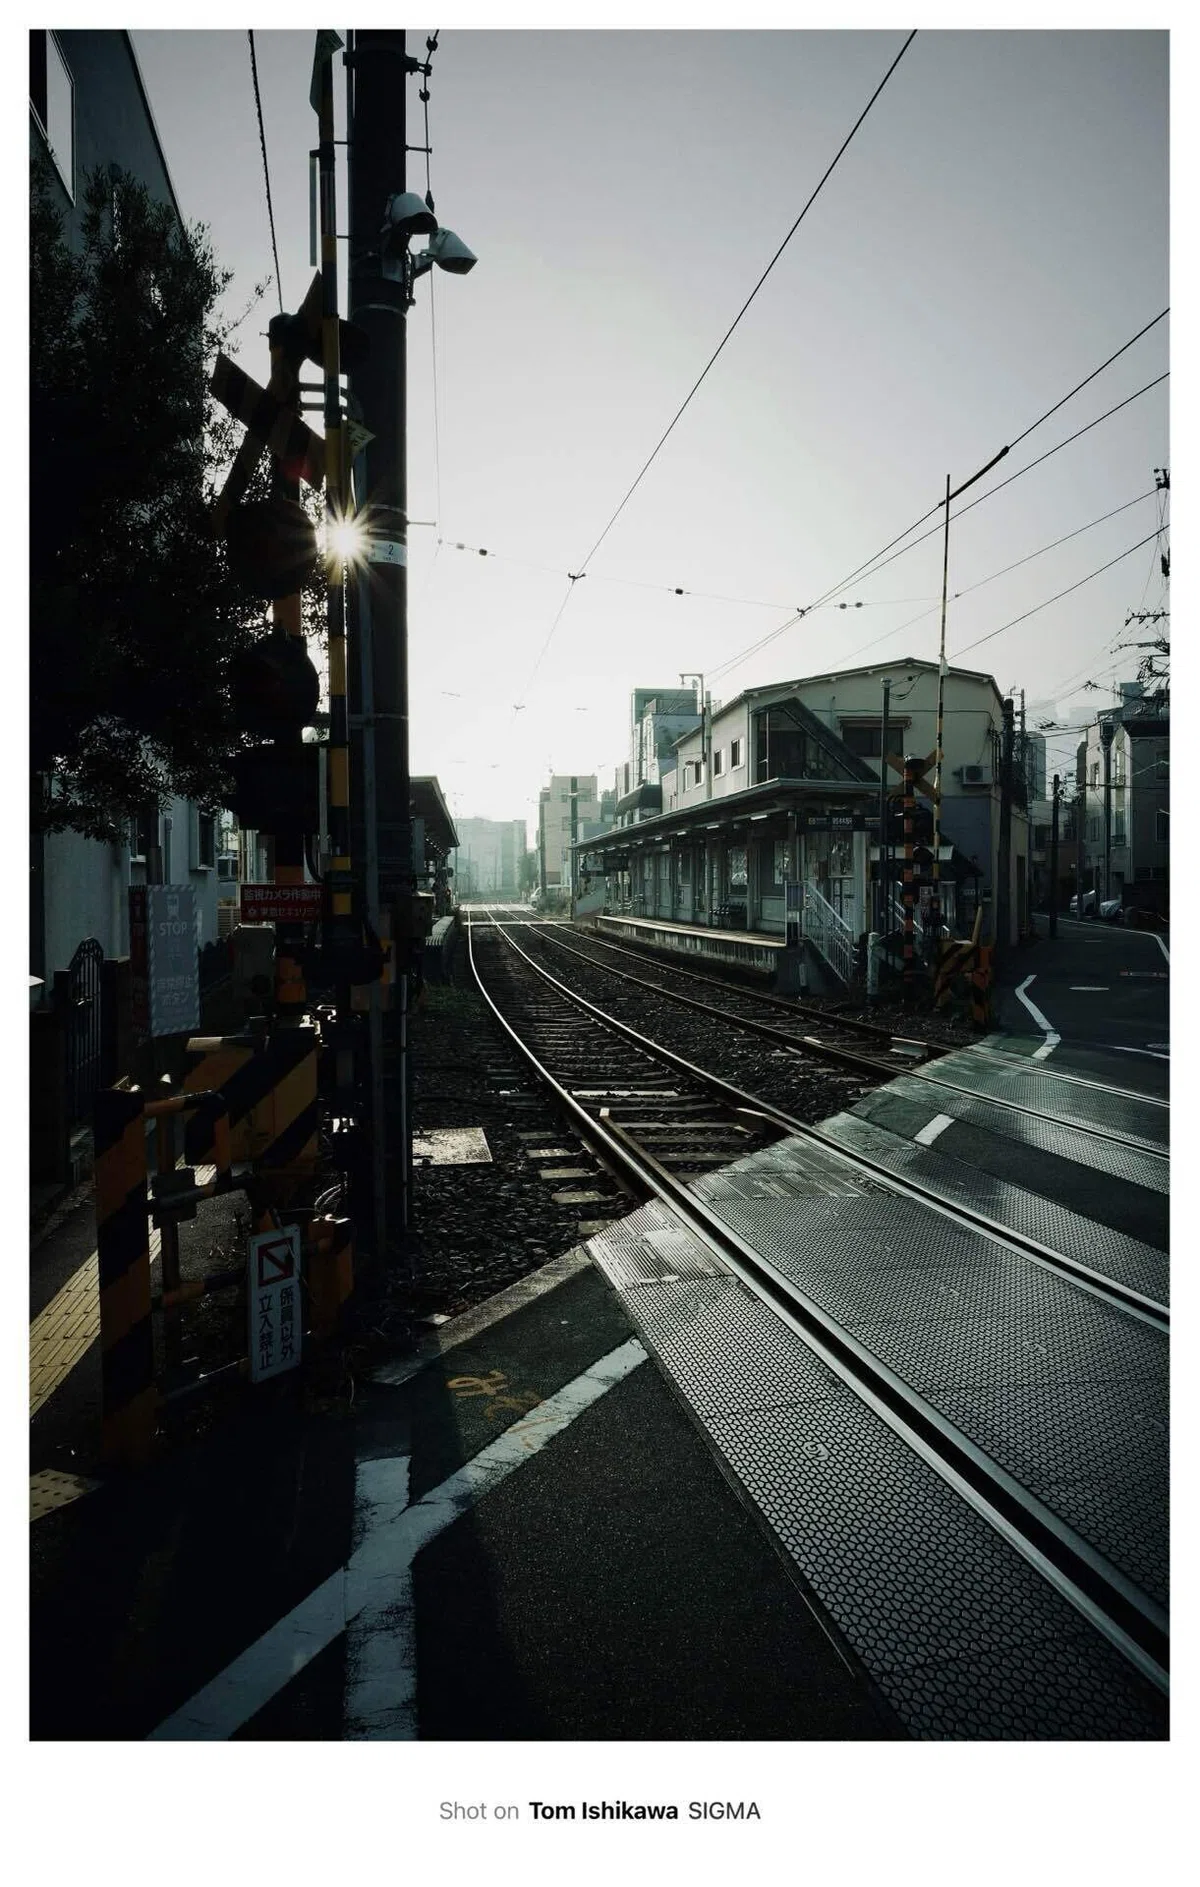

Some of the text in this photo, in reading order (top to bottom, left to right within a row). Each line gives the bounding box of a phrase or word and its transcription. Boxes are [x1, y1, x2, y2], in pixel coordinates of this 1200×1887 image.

[159, 921, 188, 936] STOP
[259, 1295, 274, 1370] 立入禁止
[280, 1286, 294, 1361] 係員以外
